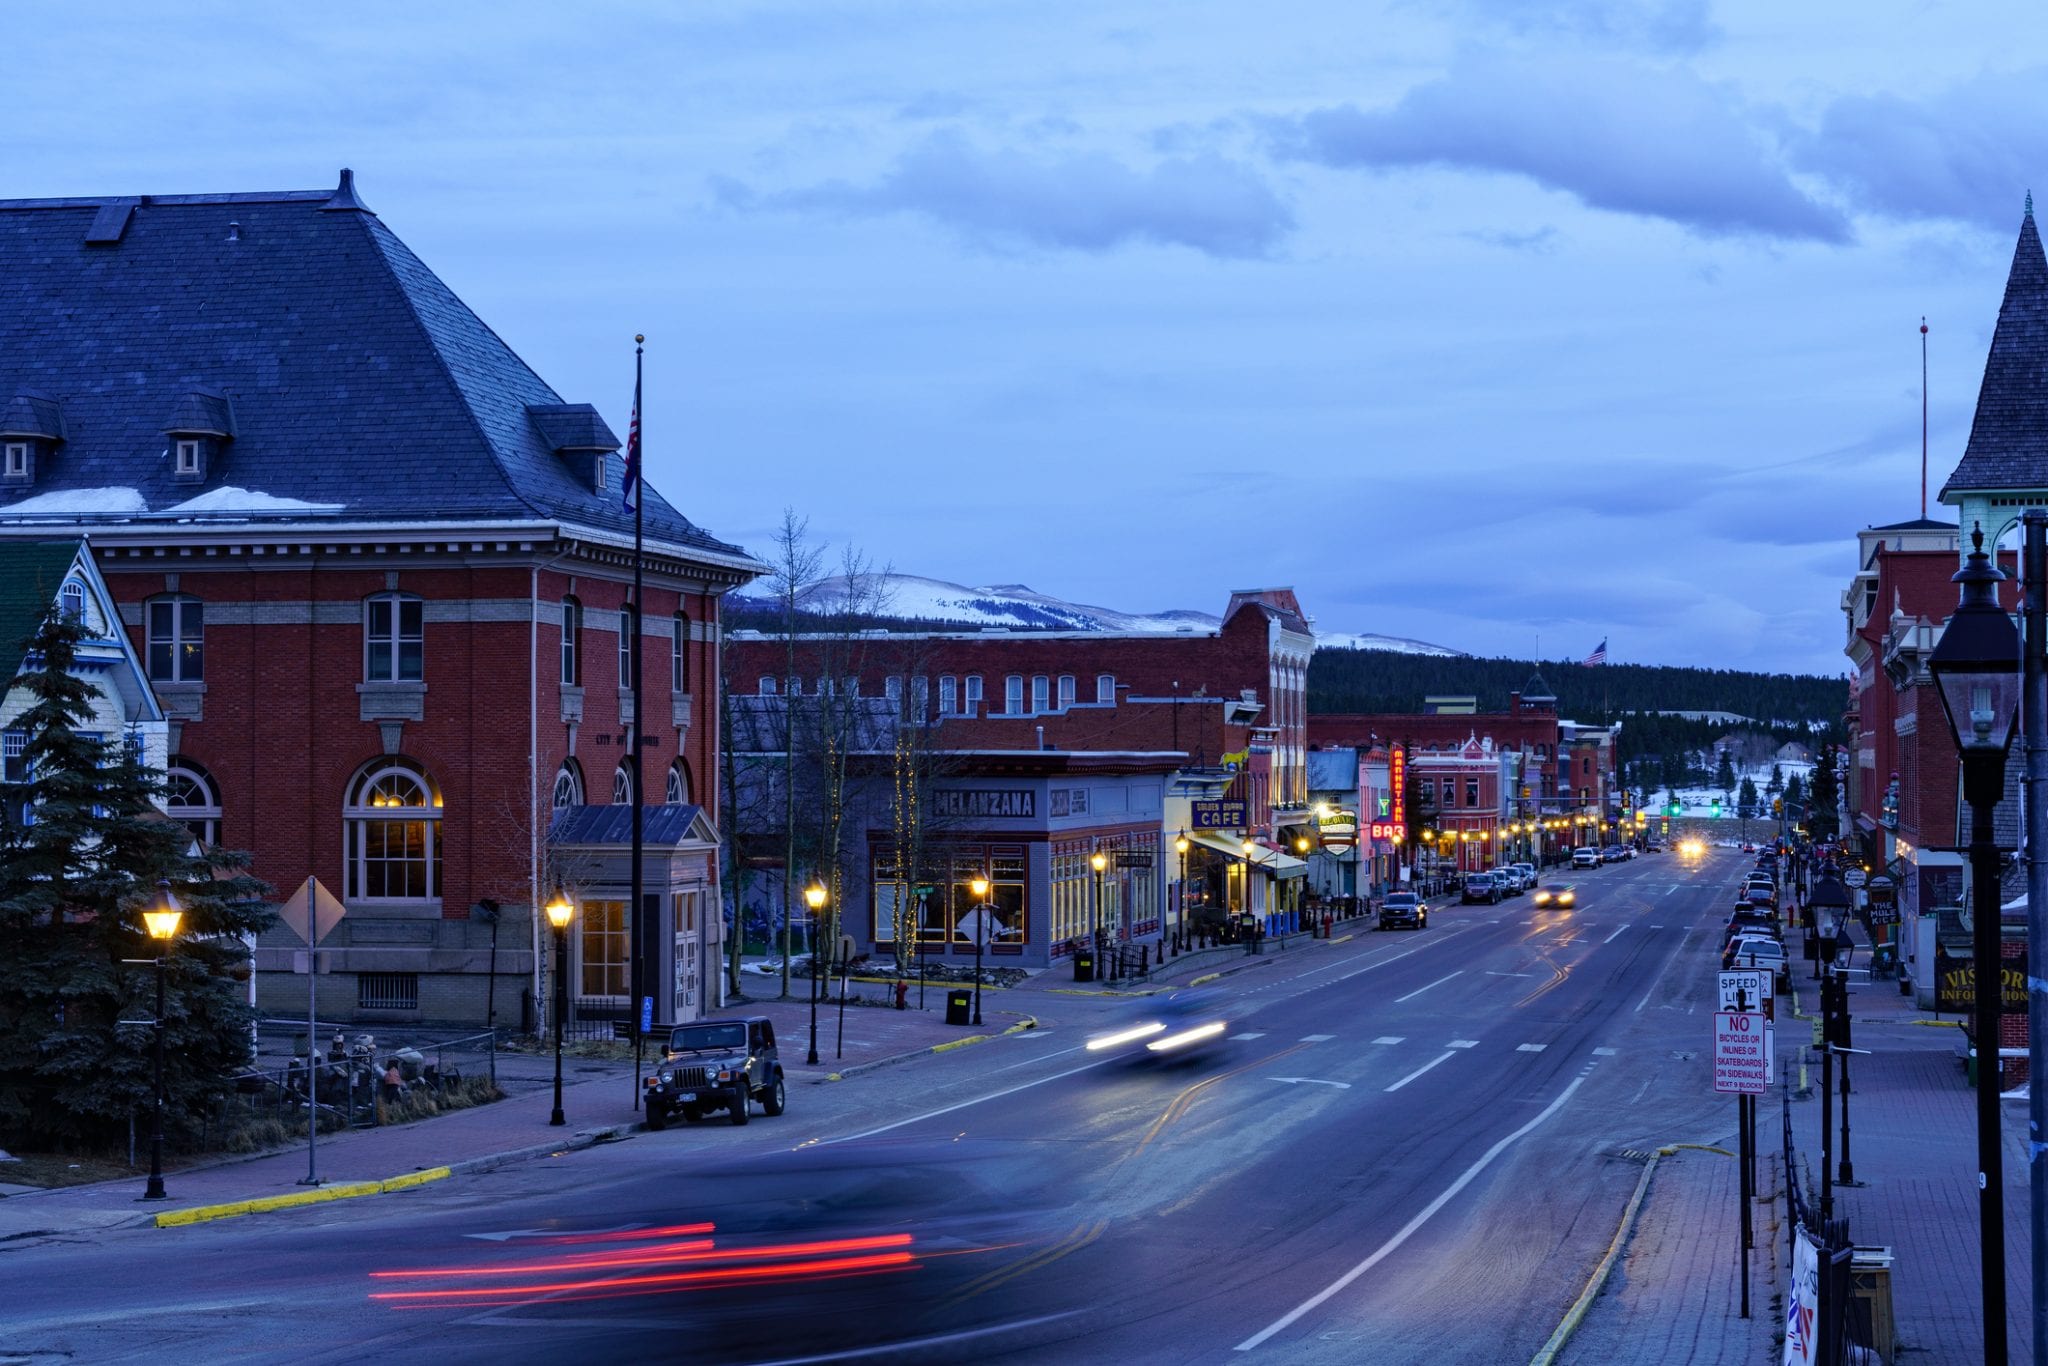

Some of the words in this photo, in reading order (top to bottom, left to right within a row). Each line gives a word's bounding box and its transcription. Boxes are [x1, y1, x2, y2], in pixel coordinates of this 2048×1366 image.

[1394, 750, 1403, 822] MANHATTAN
[935, 792, 1032, 816] MELANZANA
[1201, 812, 1240, 825] CAFE
[1372, 825, 1405, 838] BAR
[1870, 909, 1897, 917] MULE
[1721, 978, 1758, 989] SPEED
[1946, 968, 2024, 989] VISOR
[1729, 1016, 1750, 1032] NO
[1719, 1034, 1750, 1043] BICYCLES
[1750, 1035, 1760, 1044] OR
[1722, 1046, 1747, 1055] INLINES
[1747, 1047, 1757, 1055] OR
[1717, 1057, 1762, 1067] SKATEBOARDS
[1717, 1069, 1727, 1077] ON
[1727, 1070, 1762, 1080] SIDEWALKS
[1717, 1080, 1733, 1088] NEXT
